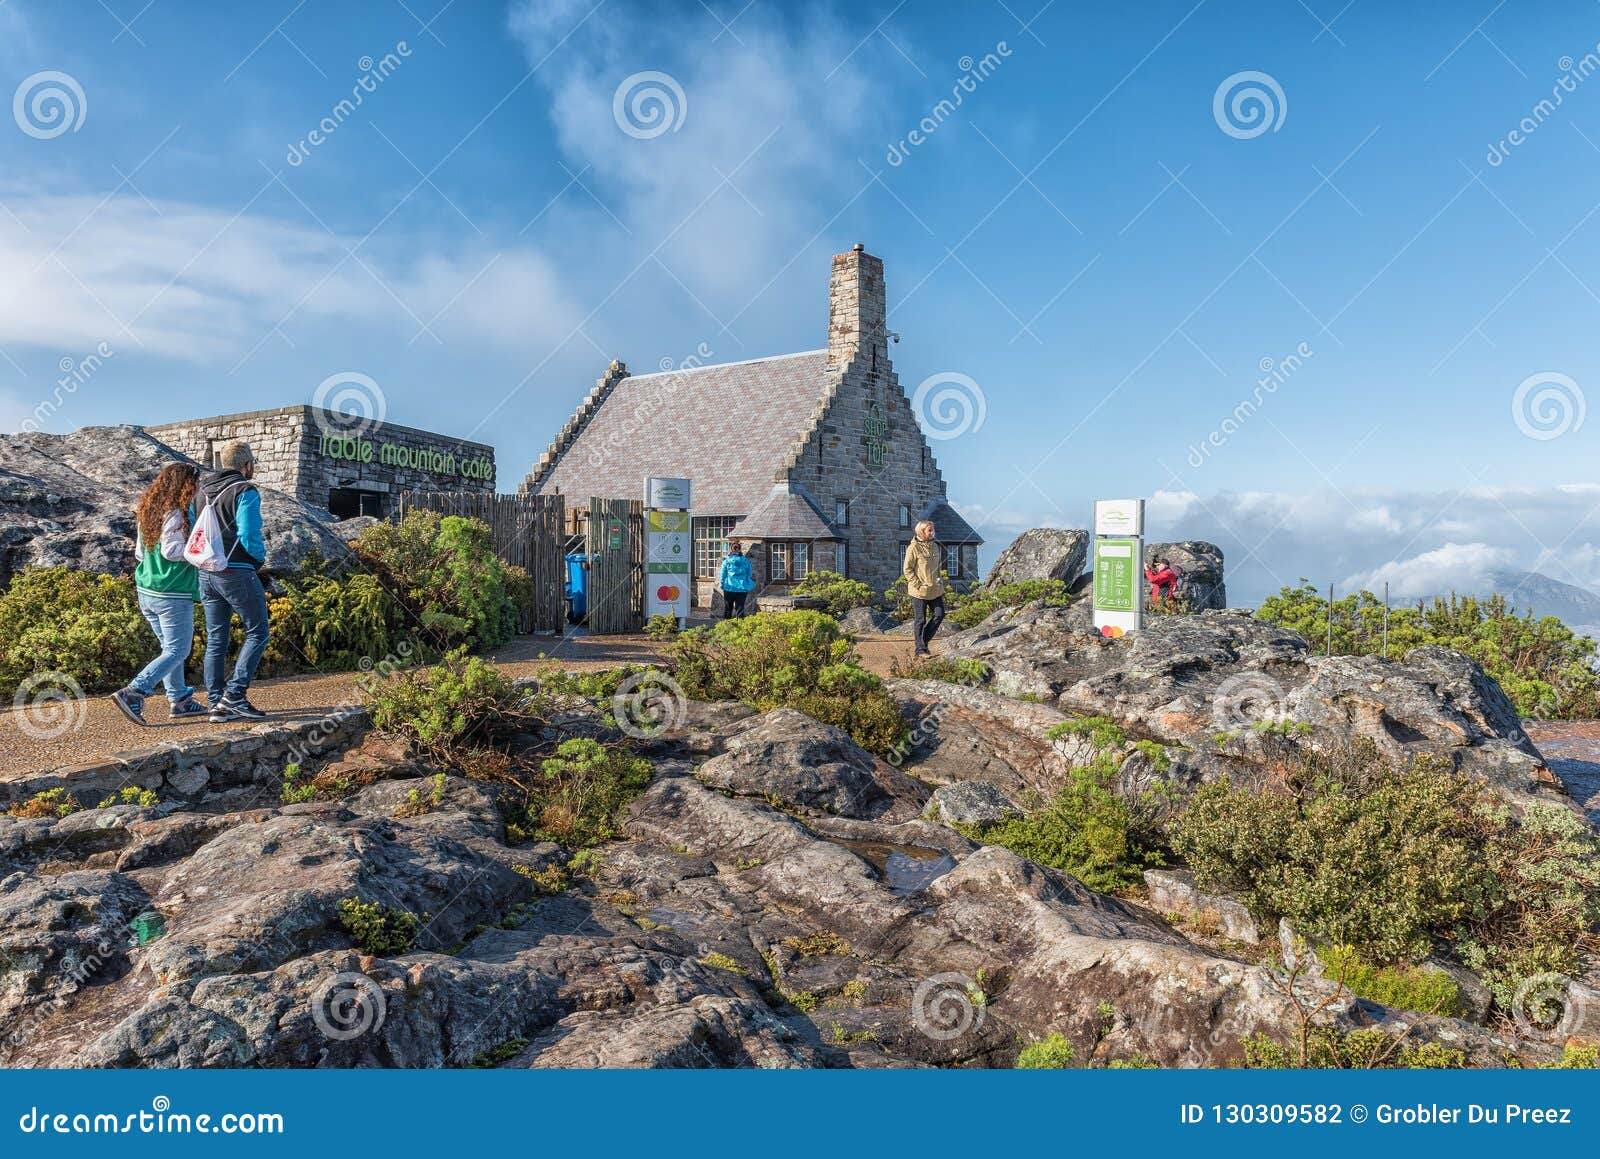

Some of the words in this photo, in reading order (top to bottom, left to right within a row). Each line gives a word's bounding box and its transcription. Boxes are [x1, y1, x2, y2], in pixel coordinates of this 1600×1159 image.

[864, 418, 888, 437] SHOP
[322, 427, 373, 464] table
[381, 442, 456, 475] mountain
[866, 441, 889, 465] TOP
